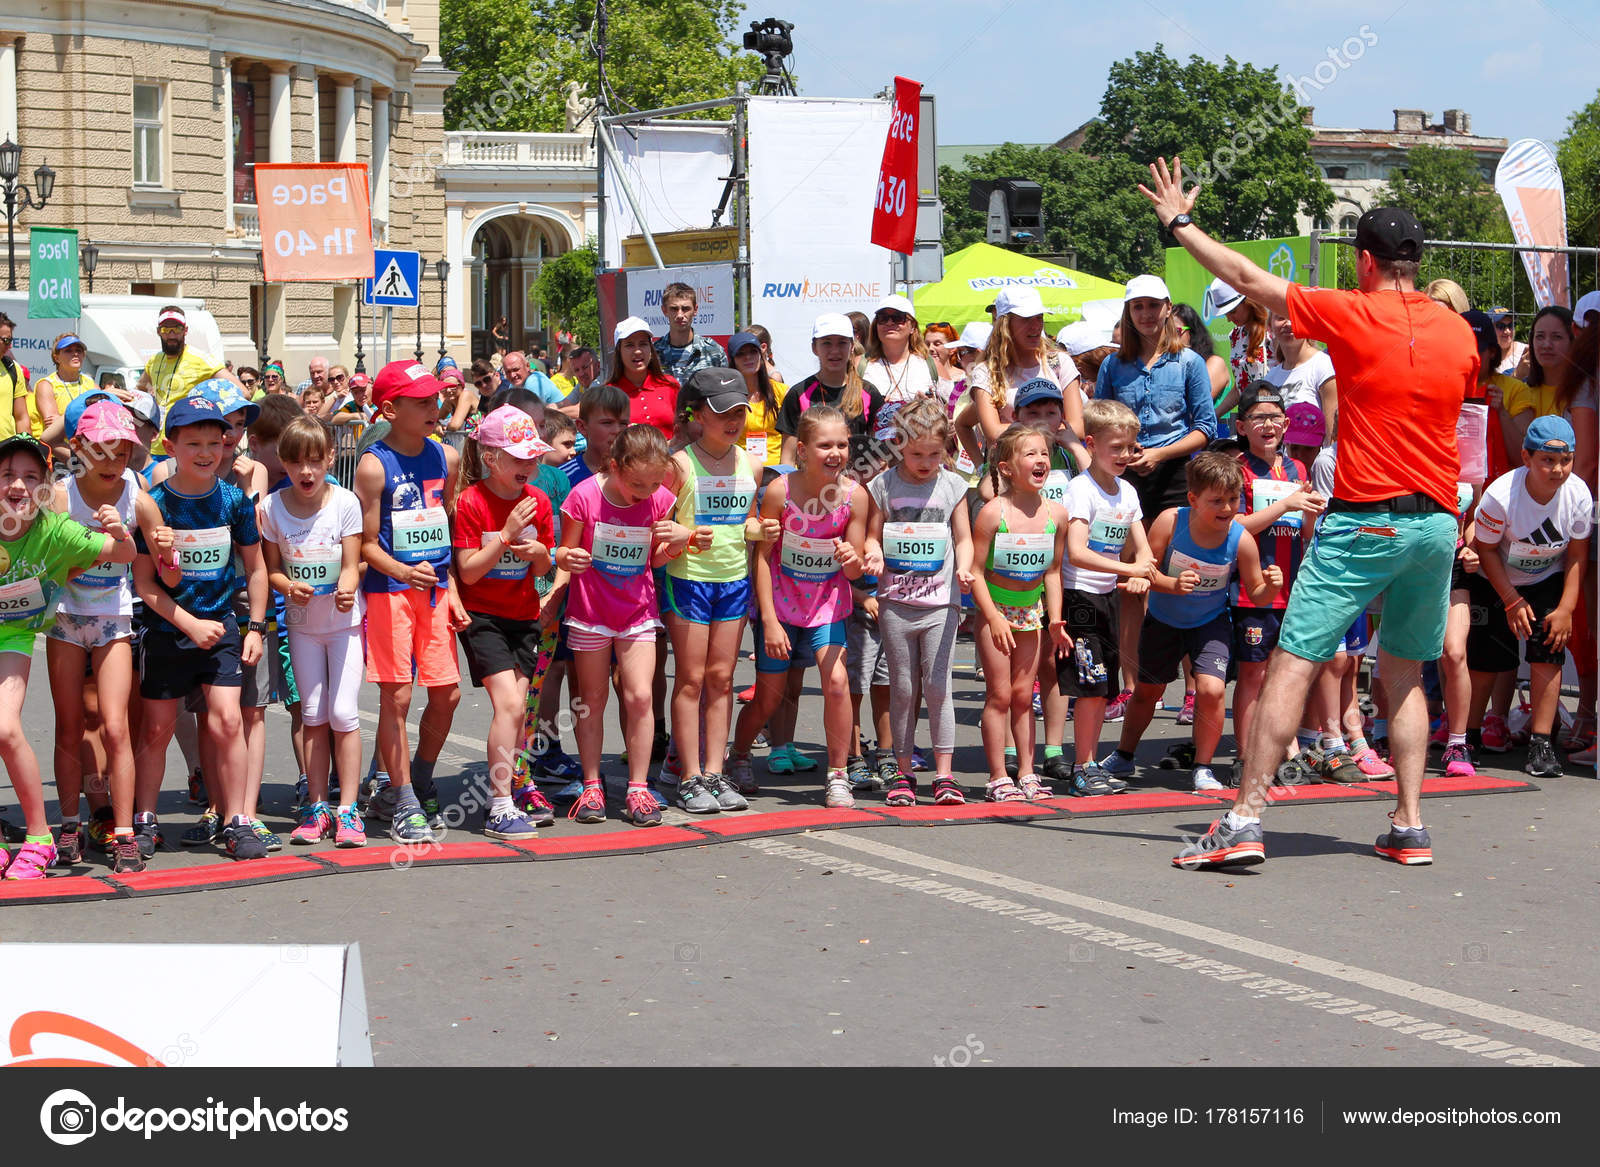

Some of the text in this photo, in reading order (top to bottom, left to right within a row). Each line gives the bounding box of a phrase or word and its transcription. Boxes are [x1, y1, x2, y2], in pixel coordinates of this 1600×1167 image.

[762, 283, 802, 298] RUN
[699, 313, 714, 325] 2017
[706, 495, 747, 509] 15000
[406, 527, 443, 544] 15040
[605, 544, 643, 560] 15047
[897, 541, 935, 555] 15015
[791, 552, 833, 568] 15044
[1006, 553, 1045, 566] 15004
[289, 565, 327, 580] 15019
[892, 575, 918, 586] LOVE
